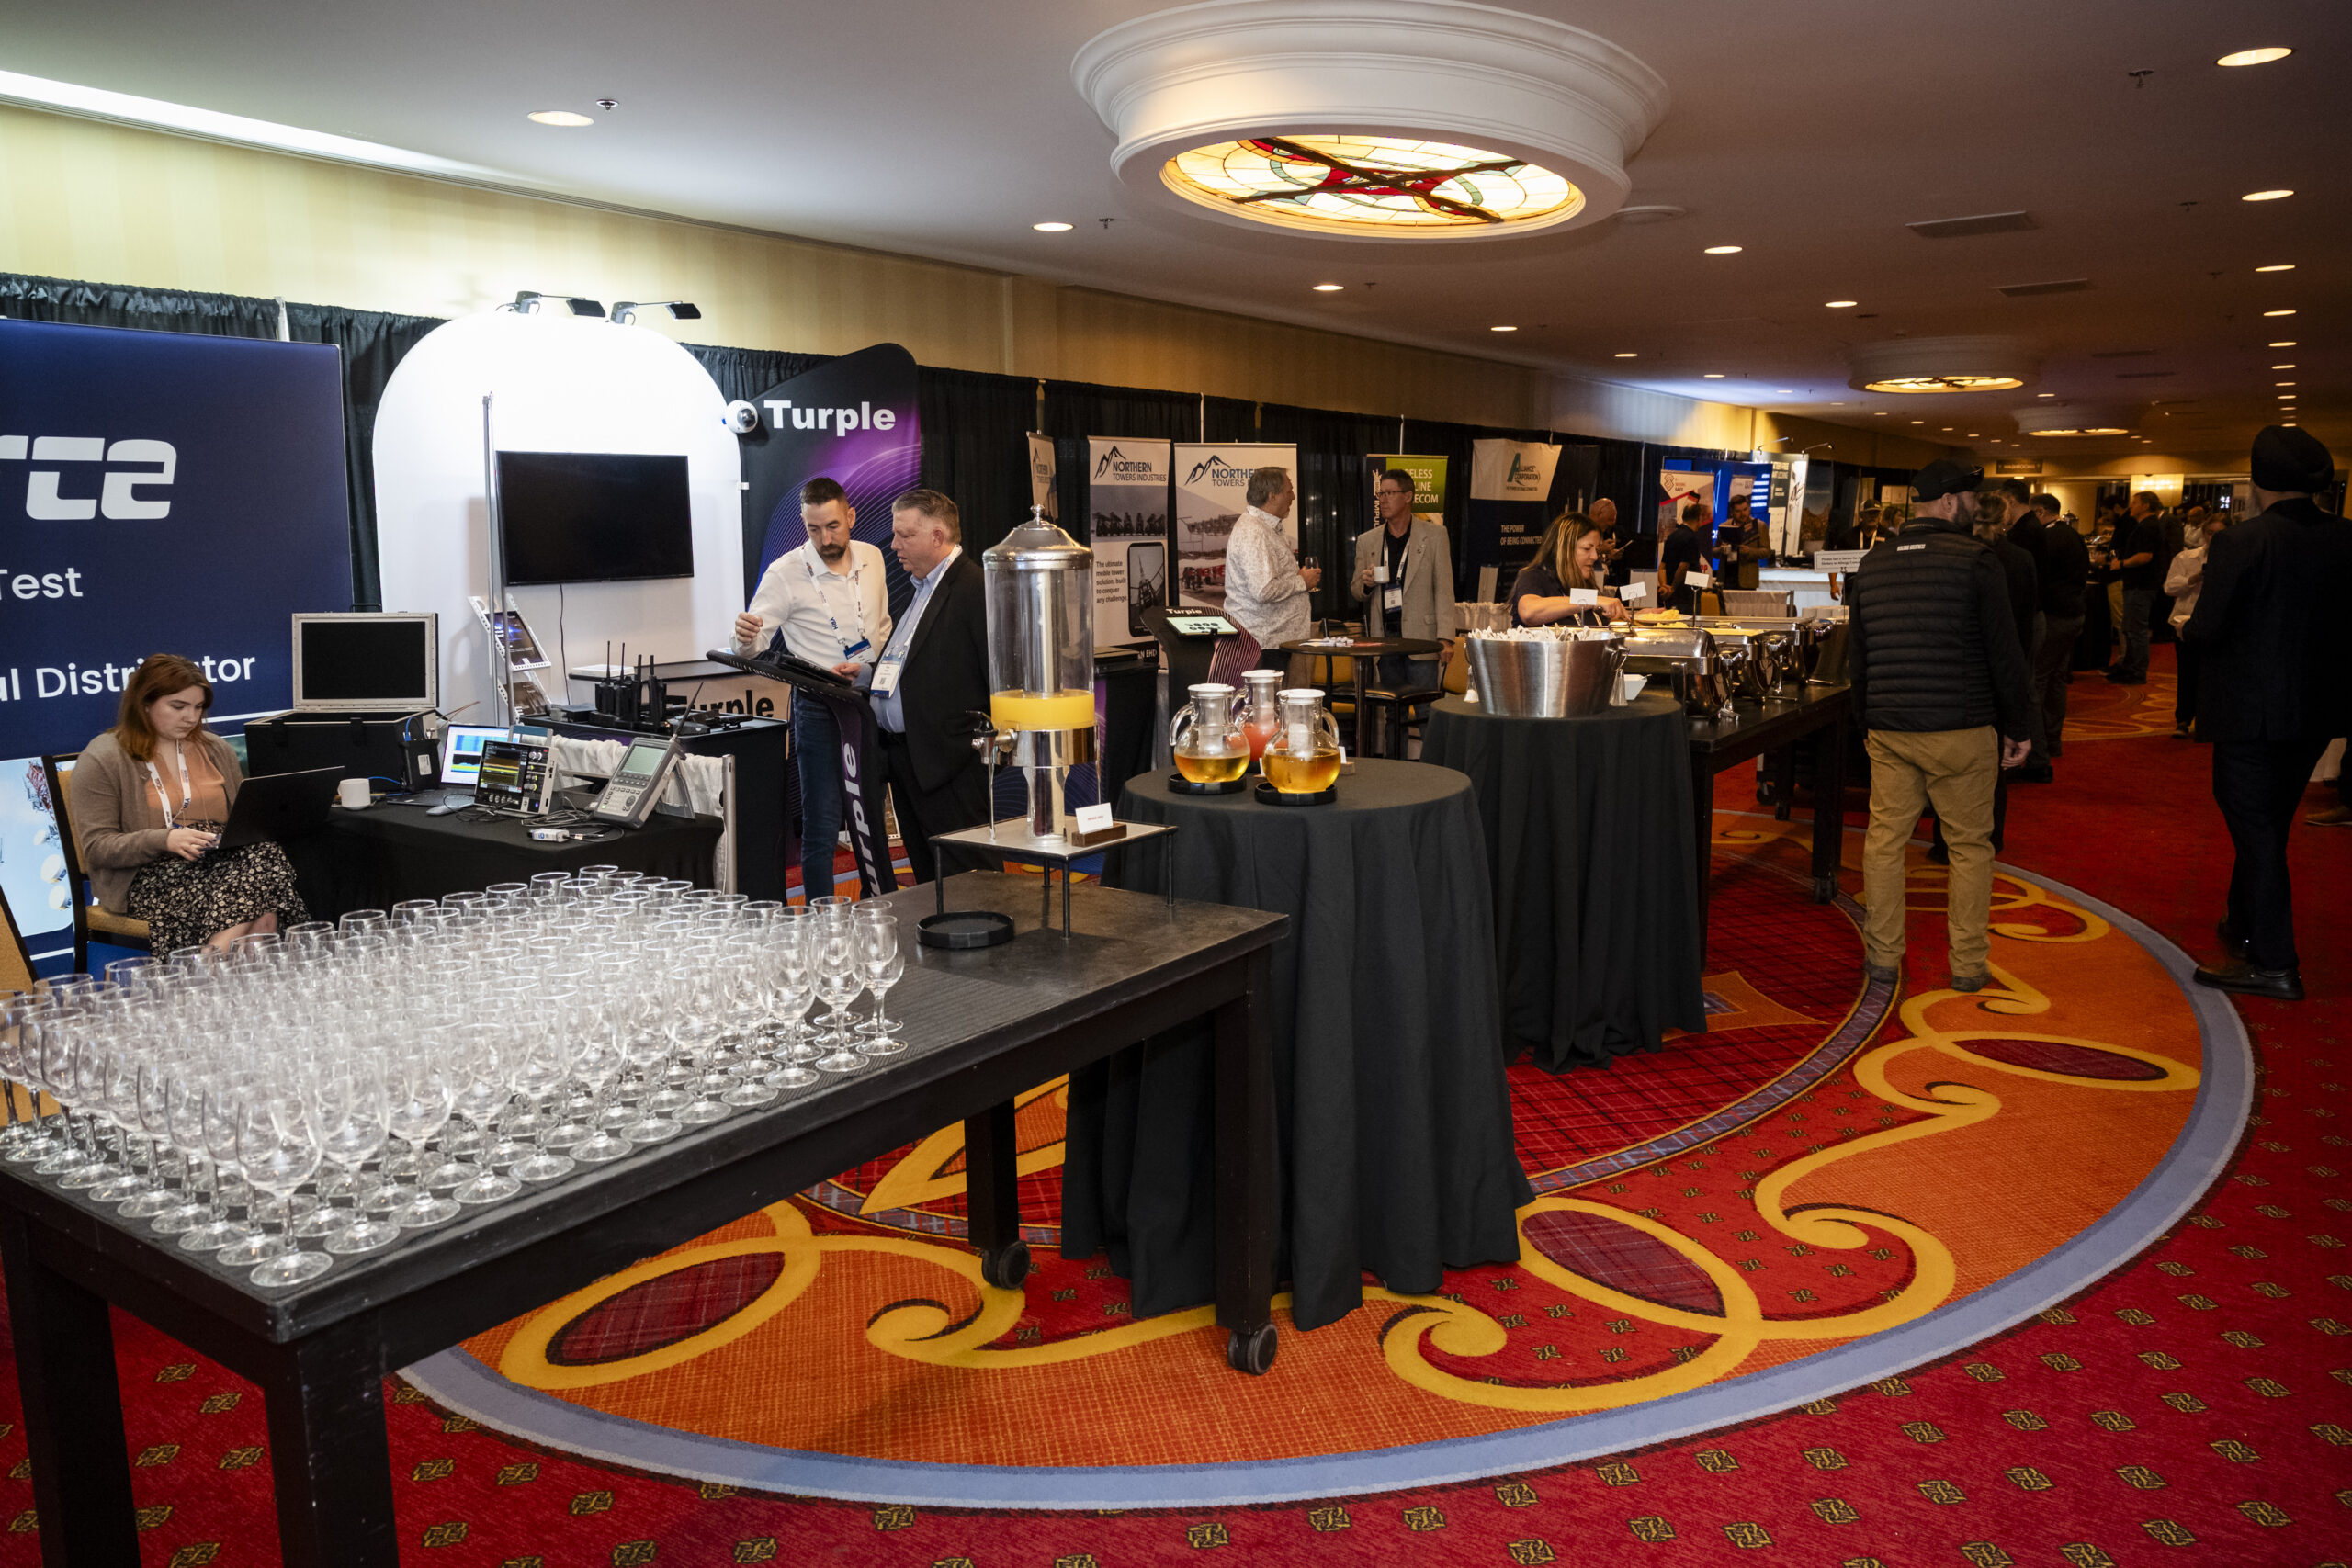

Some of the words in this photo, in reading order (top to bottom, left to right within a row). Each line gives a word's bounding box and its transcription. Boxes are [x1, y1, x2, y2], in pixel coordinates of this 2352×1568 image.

[763, 400, 896, 436] Turple
[1113, 461, 1152, 473] NORTHERN
[1113, 473, 1136, 481] TOWERS
[1137, 474, 1168, 482] INDUSTRIES
[1211, 468, 1257, 479] NORTHE
[1405, 468, 1433, 479] ELESS
[1415, 481, 1431, 491] LINE
[1412, 493, 1439, 503] ECOM
[1500, 525, 1510, 533] THE
[1510, 525, 1525, 533] POWER
[1500, 536, 1507, 546] OF
[1507, 536, 1520, 546] BEING
[35, 655, 256, 698] Distrtor
[843, 742, 881, 897] urple
